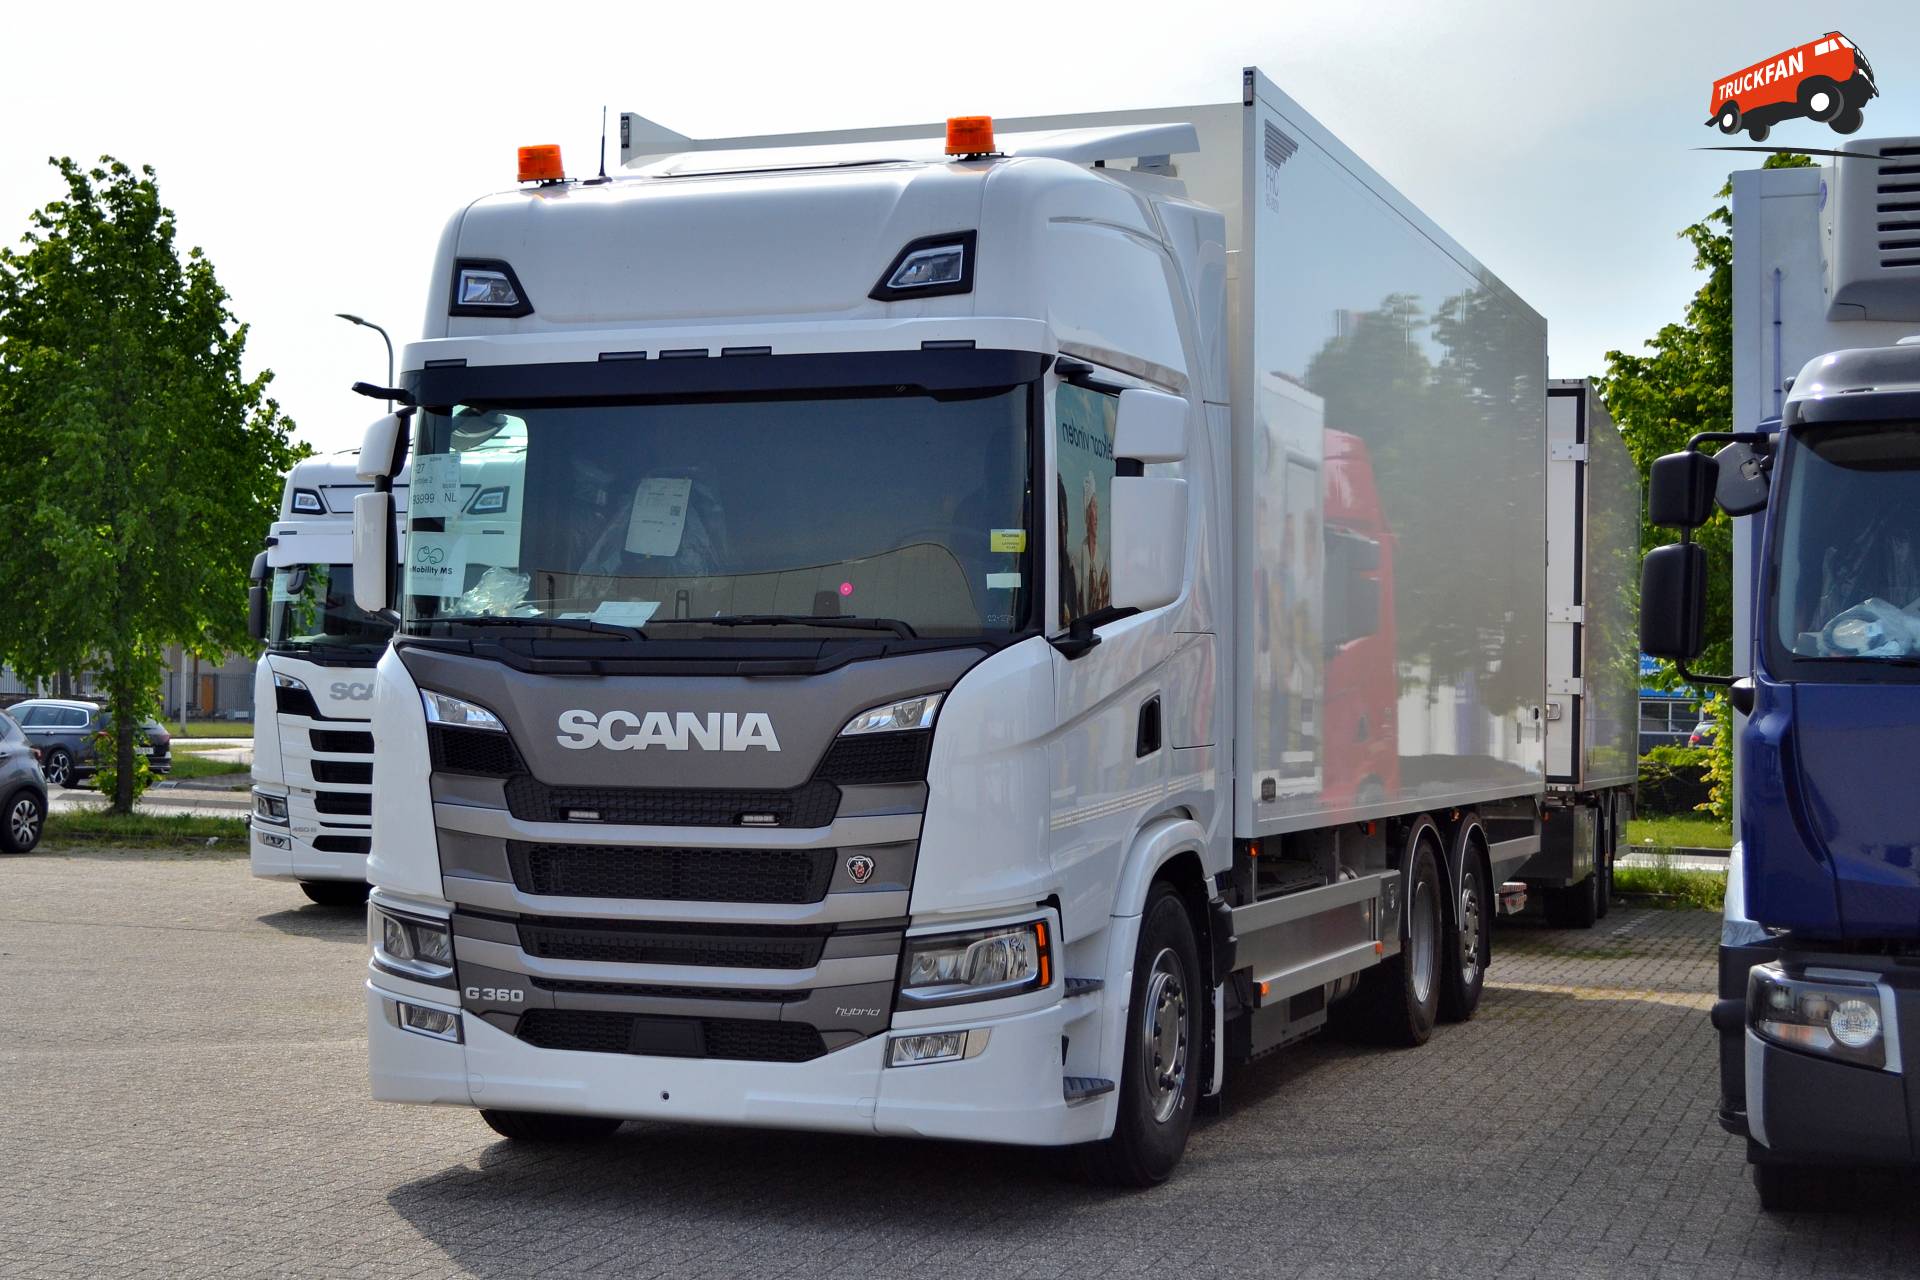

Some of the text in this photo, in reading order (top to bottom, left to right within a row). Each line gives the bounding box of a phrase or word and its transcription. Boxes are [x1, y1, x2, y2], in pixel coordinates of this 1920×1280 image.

[444, 491, 457, 503] NL
[412, 565, 453, 576] Mobility MS
[556, 708, 782, 753] SCANIA
[835, 1006, 881, 1017] hybrid
